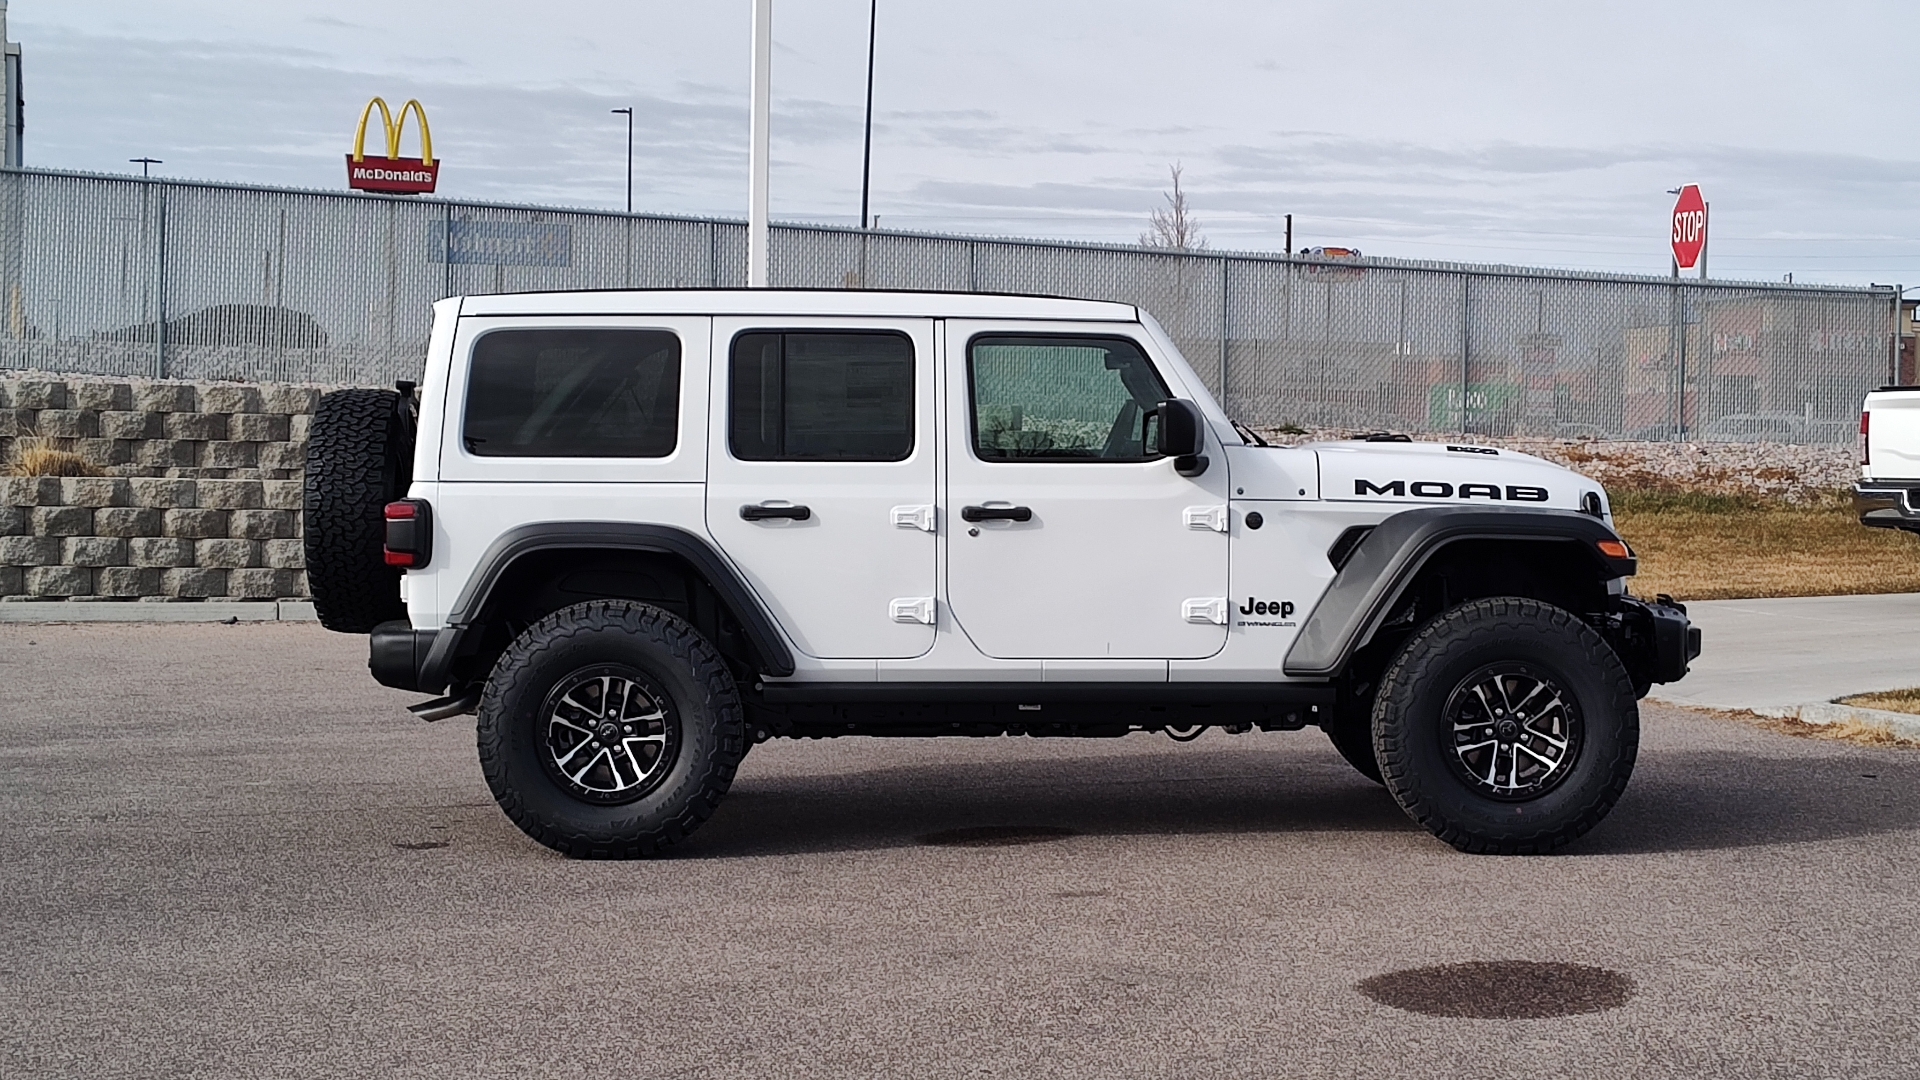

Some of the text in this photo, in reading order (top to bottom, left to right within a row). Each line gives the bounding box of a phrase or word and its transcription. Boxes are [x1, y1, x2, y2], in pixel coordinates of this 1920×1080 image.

[353, 167, 432, 183] McDonald's
[1673, 210, 1703, 243] STOP
[1354, 479, 1549, 502] MOAB
[1239, 596, 1294, 619] Jeep
